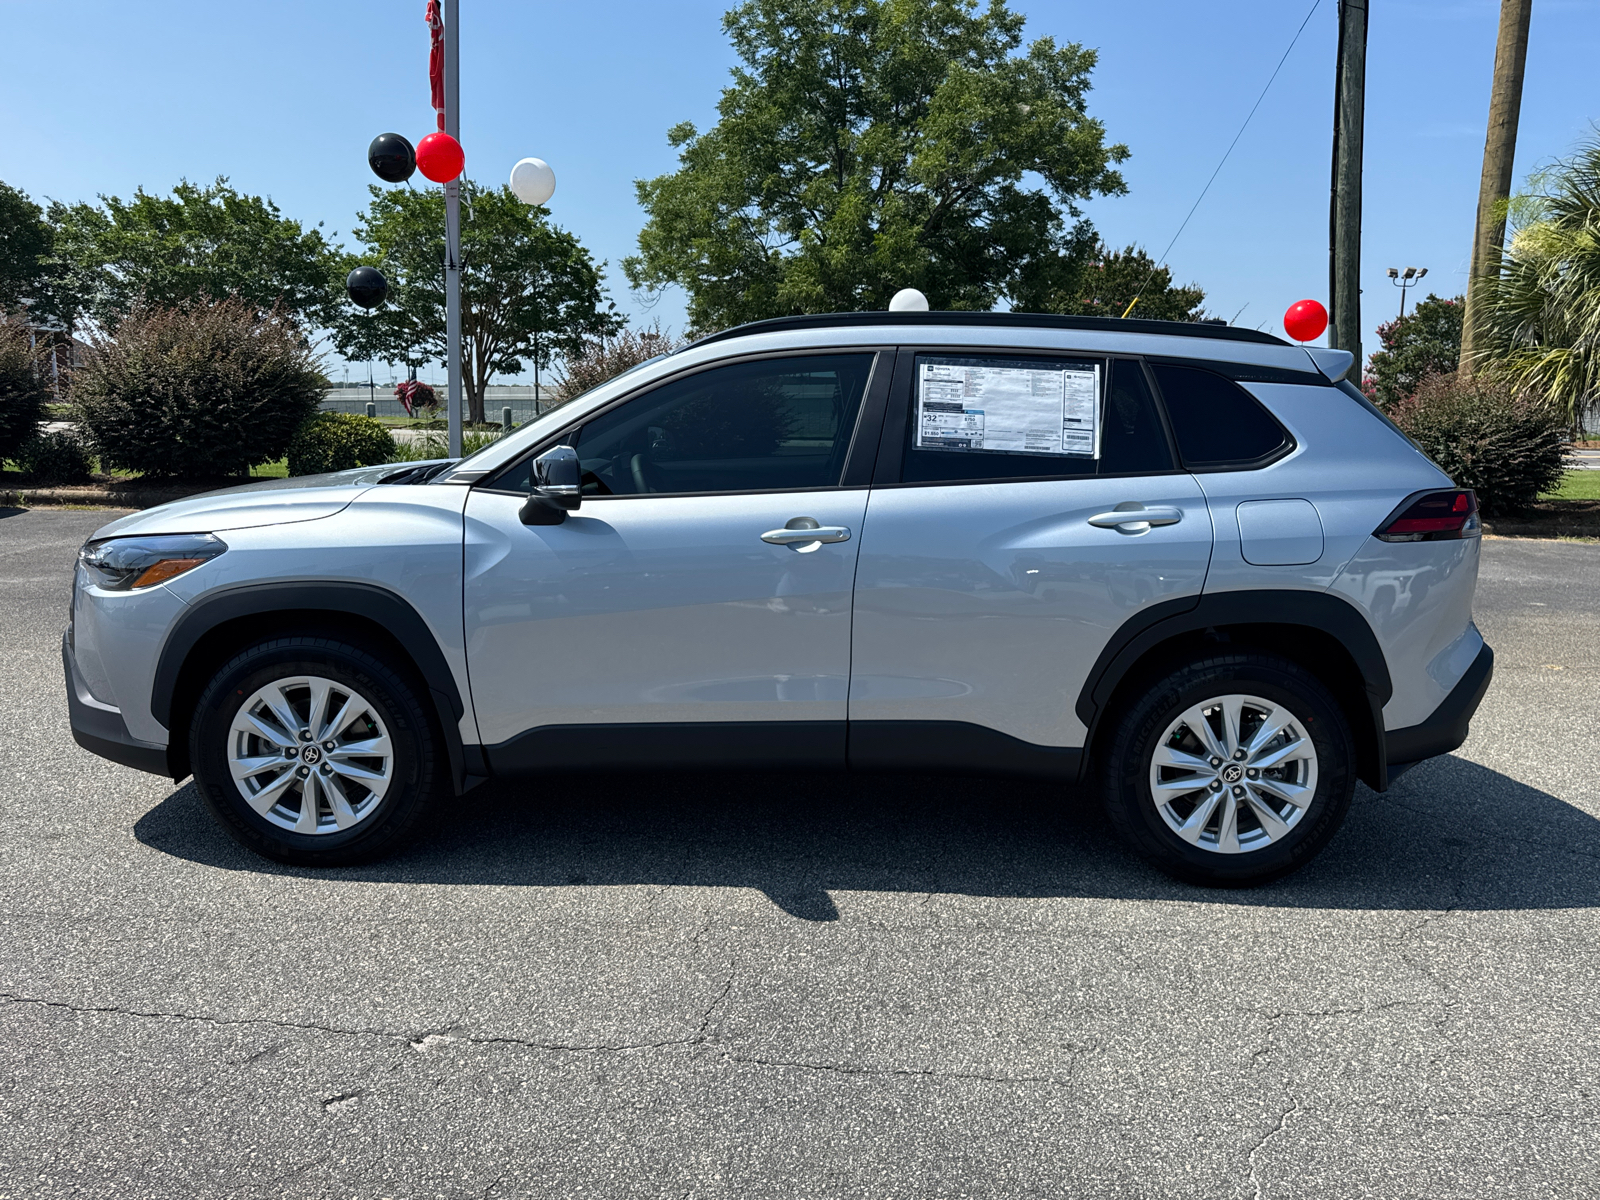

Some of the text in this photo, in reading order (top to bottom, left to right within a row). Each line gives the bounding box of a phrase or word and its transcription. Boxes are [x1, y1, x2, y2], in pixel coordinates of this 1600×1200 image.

[926, 414, 937, 422] 32
[355, 672, 408, 728] MICHELIN
[1132, 694, 1179, 755] MICHELIN
[209, 784, 260, 841] MICHELIN
[1292, 797, 1339, 859] MICHELIN
